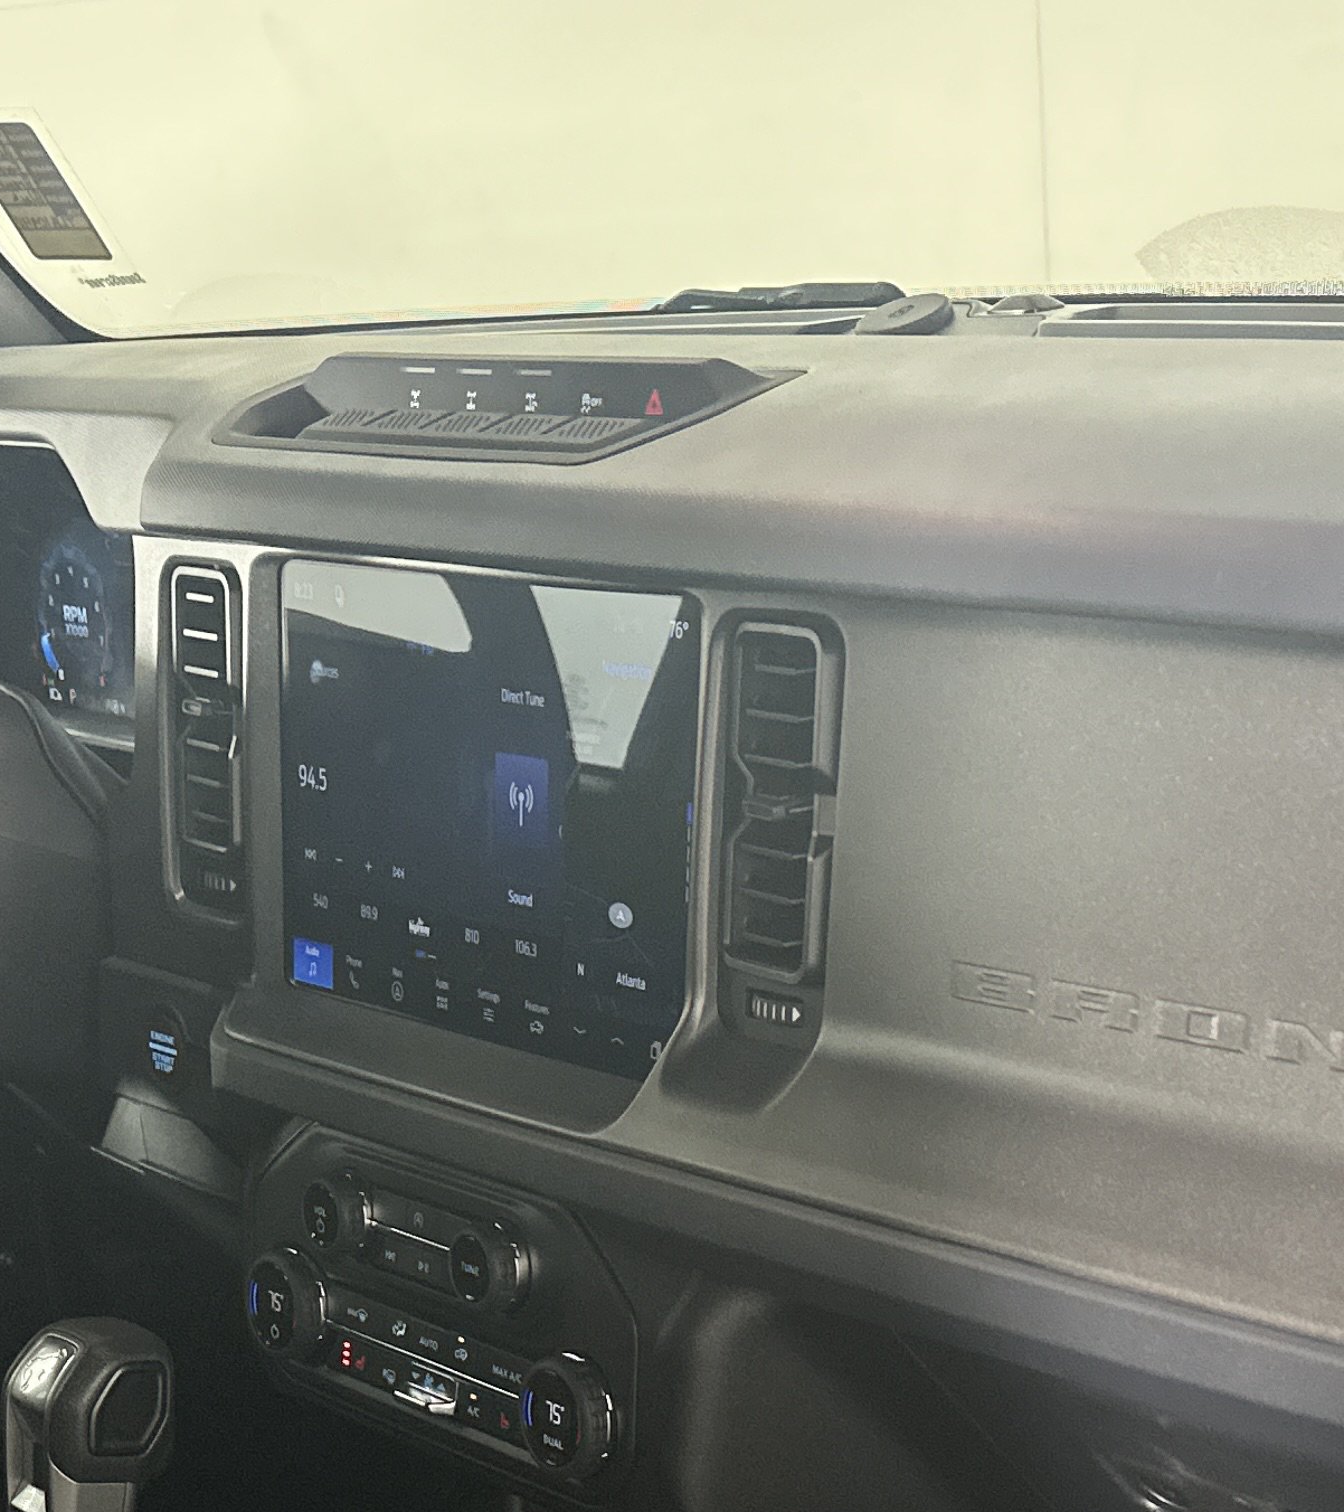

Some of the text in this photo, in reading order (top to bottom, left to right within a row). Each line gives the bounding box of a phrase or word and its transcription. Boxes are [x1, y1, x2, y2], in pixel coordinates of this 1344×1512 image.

[62, 604, 88, 624] RPM
[501, 687, 545, 708] Direct Tune
[297, 763, 328, 792] 94.5
[507, 888, 533, 908] Sound
[615, 970, 646, 992] Atlanta
